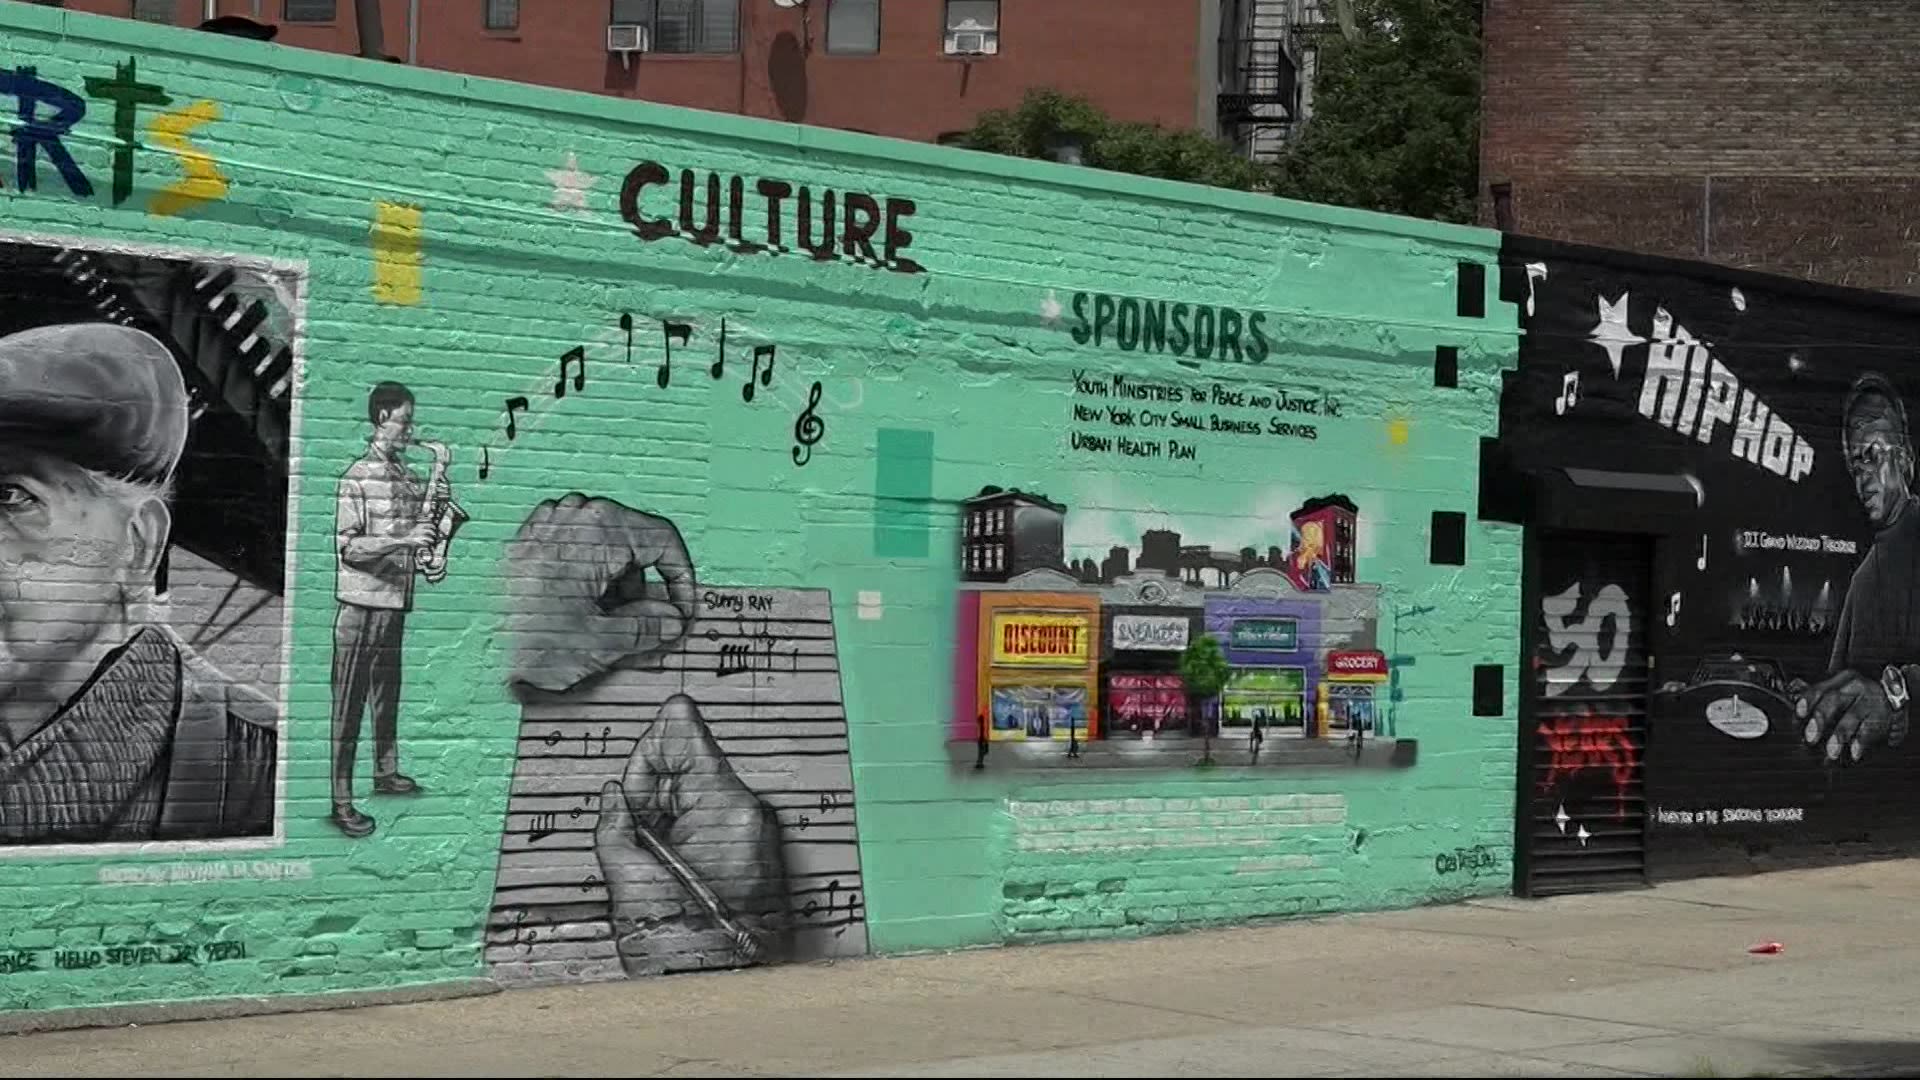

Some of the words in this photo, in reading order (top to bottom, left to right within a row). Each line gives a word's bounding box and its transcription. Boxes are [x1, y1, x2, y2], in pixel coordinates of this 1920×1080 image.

[620, 160, 928, 273] CULTURE
[1071, 292, 1270, 364] SPONSORS
[1073, 404, 1103, 421] NEW
[1106, 405, 1136, 427] YORK
[1140, 410, 1167, 427] CITY
[1117, 437, 1161, 457] HEALTH
[1168, 440, 1196, 460] PLAN
[748, 594, 773, 612] RAY
[1004, 624, 1079, 654] DISCOUNT
[1335, 656, 1379, 669] GROCERY
[54, 950, 102, 969] HELLO
